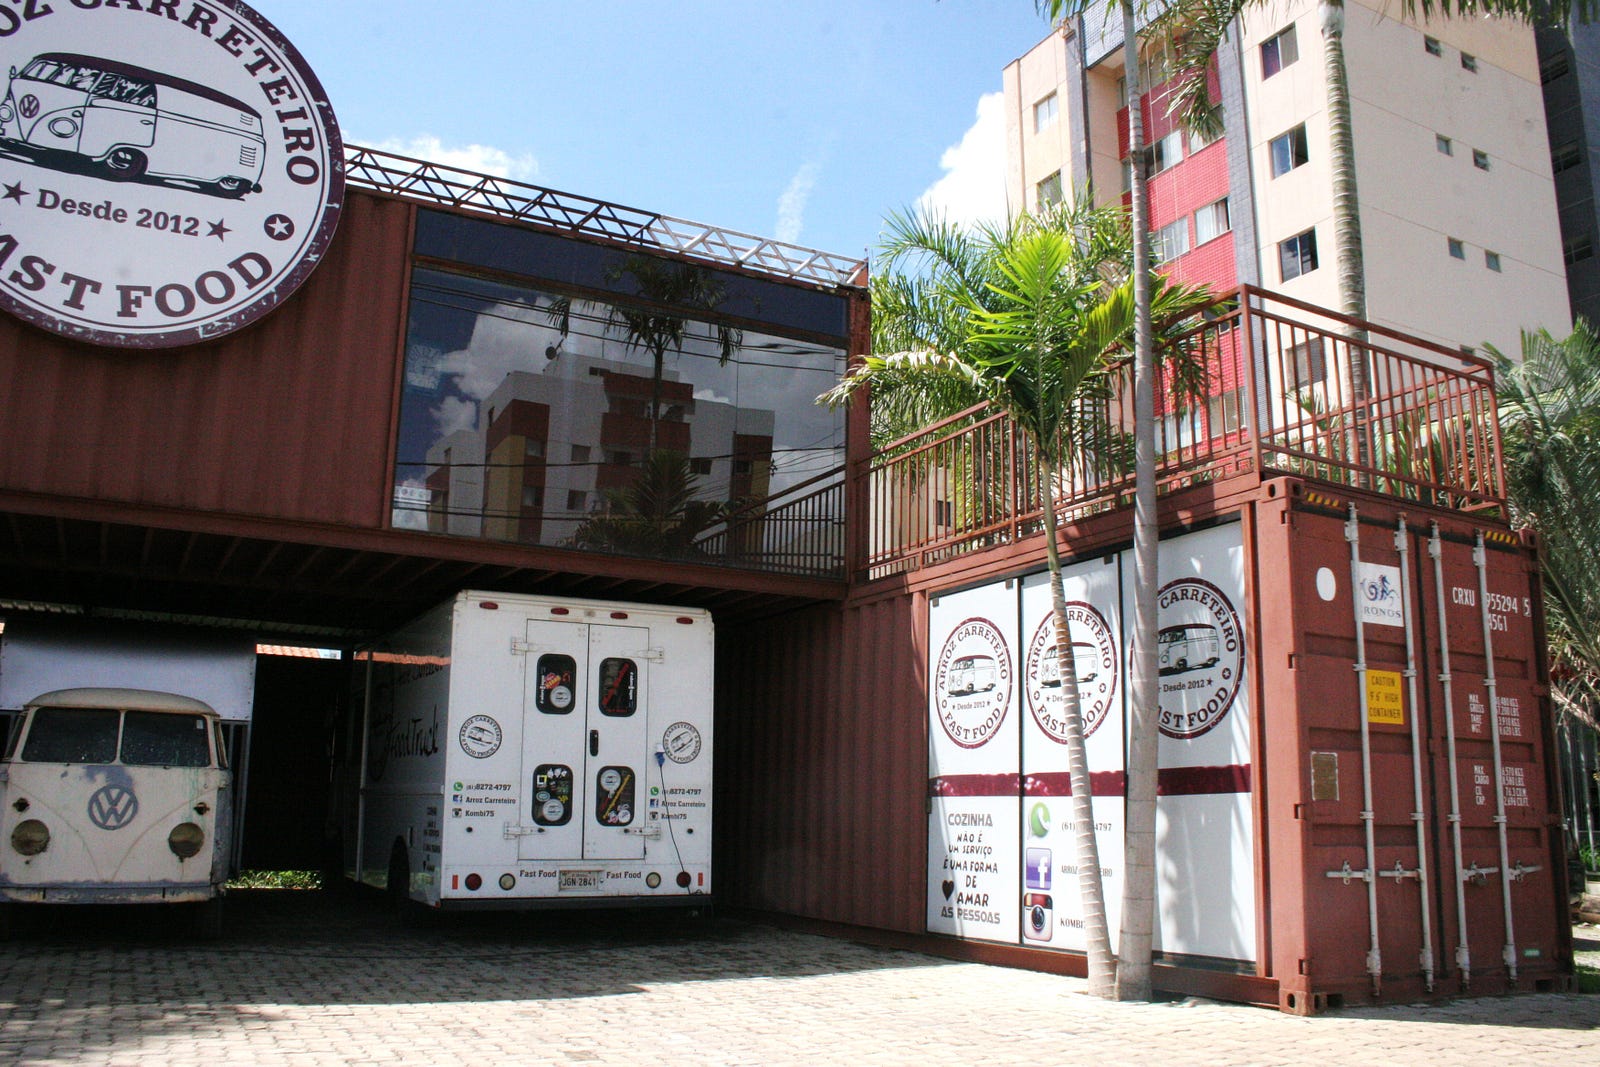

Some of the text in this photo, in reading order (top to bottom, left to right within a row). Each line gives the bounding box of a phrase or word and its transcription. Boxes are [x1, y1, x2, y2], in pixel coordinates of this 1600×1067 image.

[37, 188, 200, 237] Desde 2012
[115, 251, 273, 318] FOOD
[1452, 586, 1476, 607] CRXU
[1160, 588, 1237, 652] CARRETEIRO
[1363, 606, 1402, 618] RONOS
[939, 625, 1008, 690] ARROZ CARRETEIRO
[1030, 627, 1051, 681] ARROZ
[1163, 679, 1205, 692] Desde 2012
[1187, 686, 1228, 727] FOOD
[945, 707, 1001, 740] FAST FOOD
[1038, 704, 1066, 735] FAST
[465, 809, 495, 817] Kombi75
[948, 813, 993, 827] COZINHA
[957, 830, 984, 843] NÃO É
[949, 844, 993, 859] UM SERVIÇO
[519, 869, 557, 878] Fast Food
[943, 855, 998, 874] É UMA FORMA
[606, 871, 642, 879] Fast Food
[965, 874, 978, 889] DE
[956, 892, 990, 908] AMAR
[941, 906, 1001, 925] AS PESSOAS
